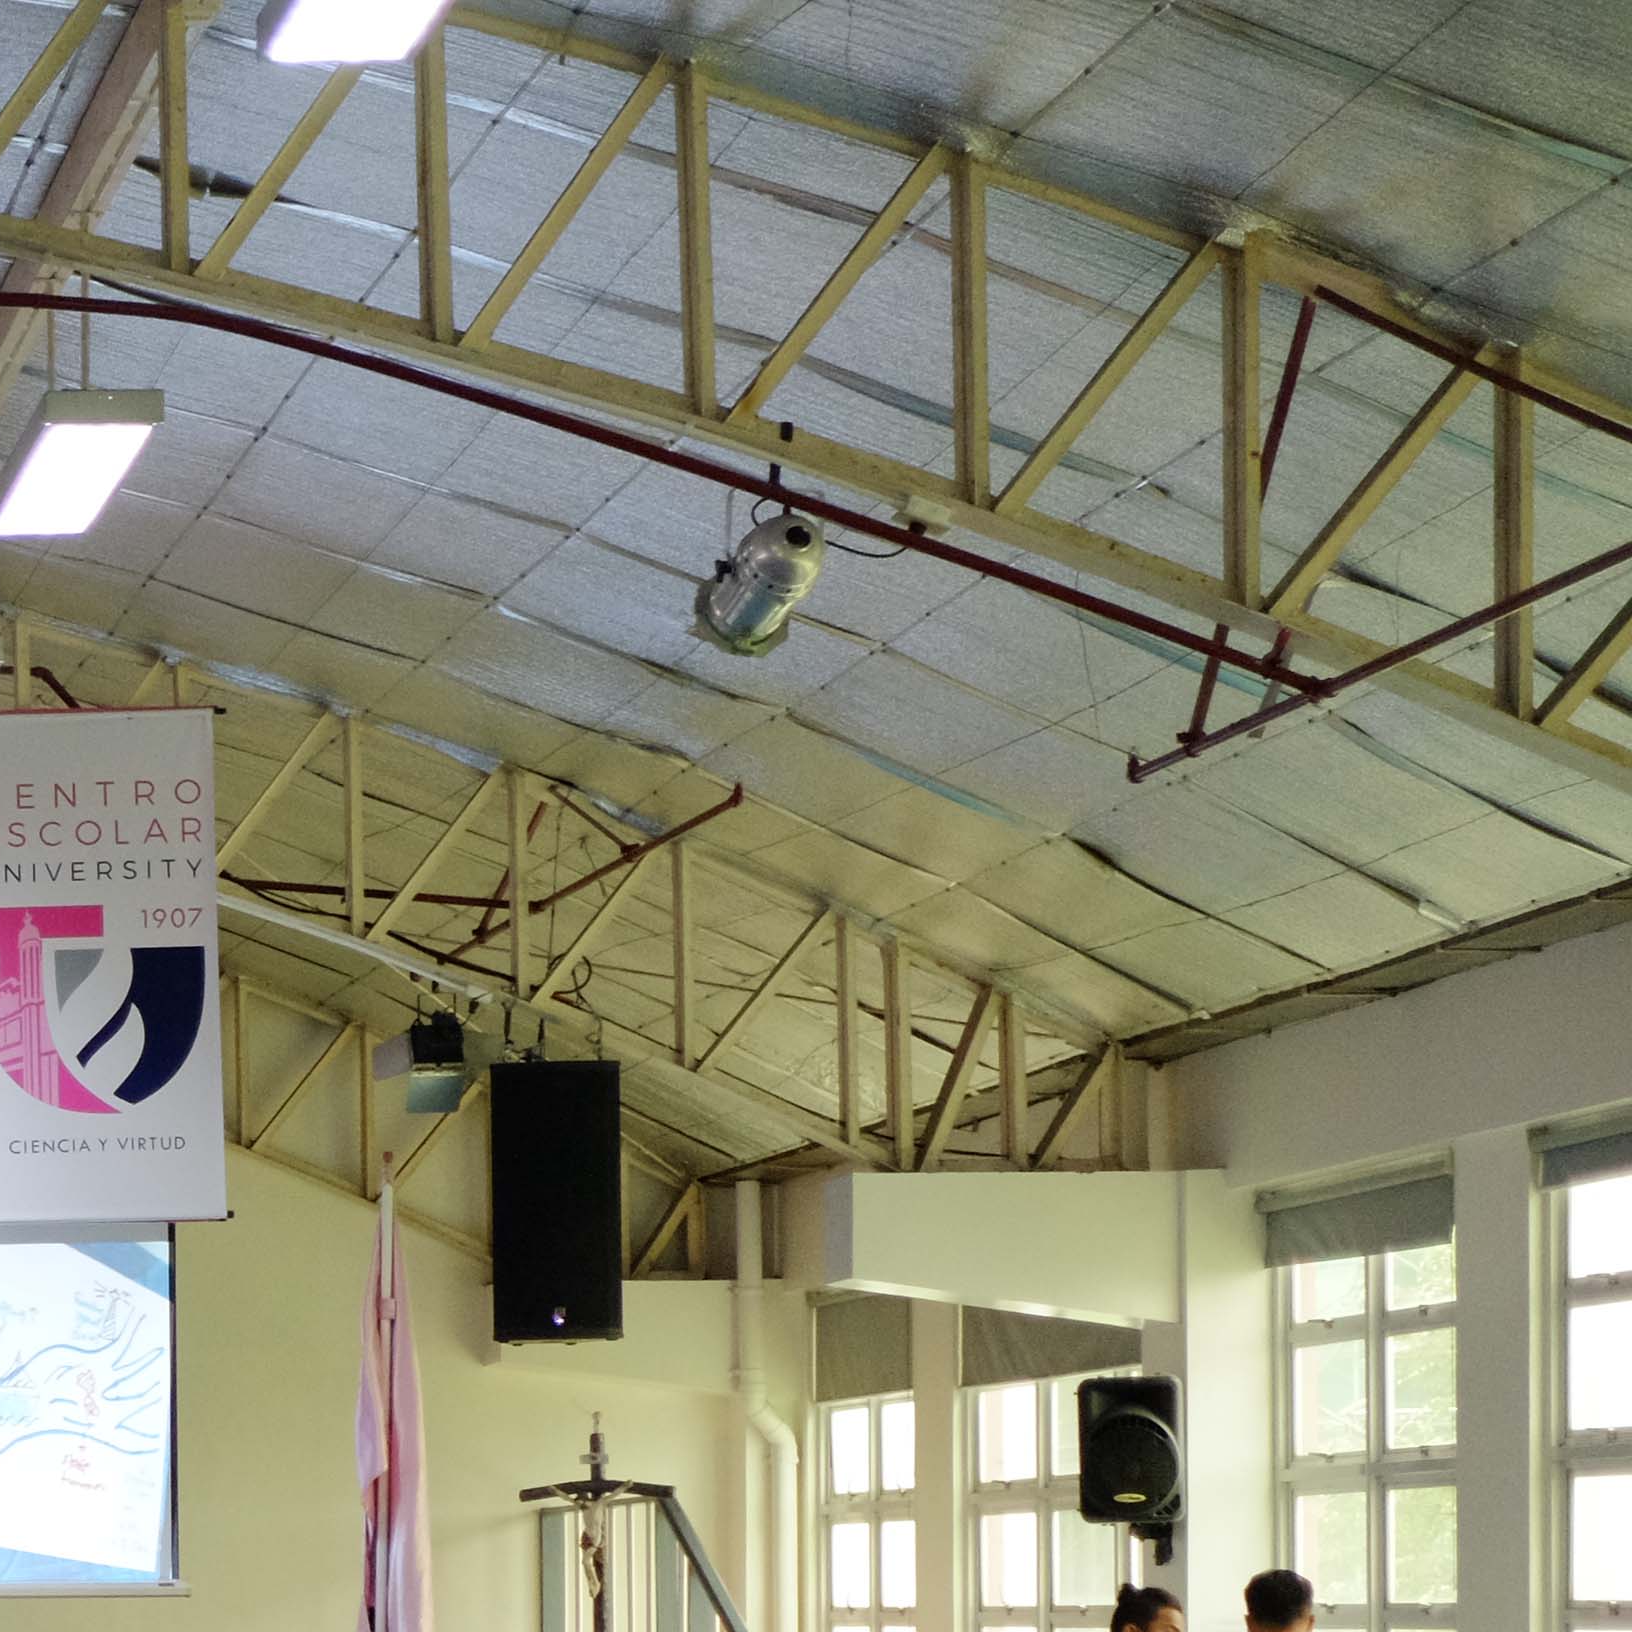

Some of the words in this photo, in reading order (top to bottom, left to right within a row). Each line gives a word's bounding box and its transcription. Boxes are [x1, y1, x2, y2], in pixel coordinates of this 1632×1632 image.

[139, 906, 204, 930] 1907
[8, 1135, 92, 1155] CIENCIA
[97, 1136, 110, 1153] Y
[117, 1135, 187, 1152] VIRTUD
